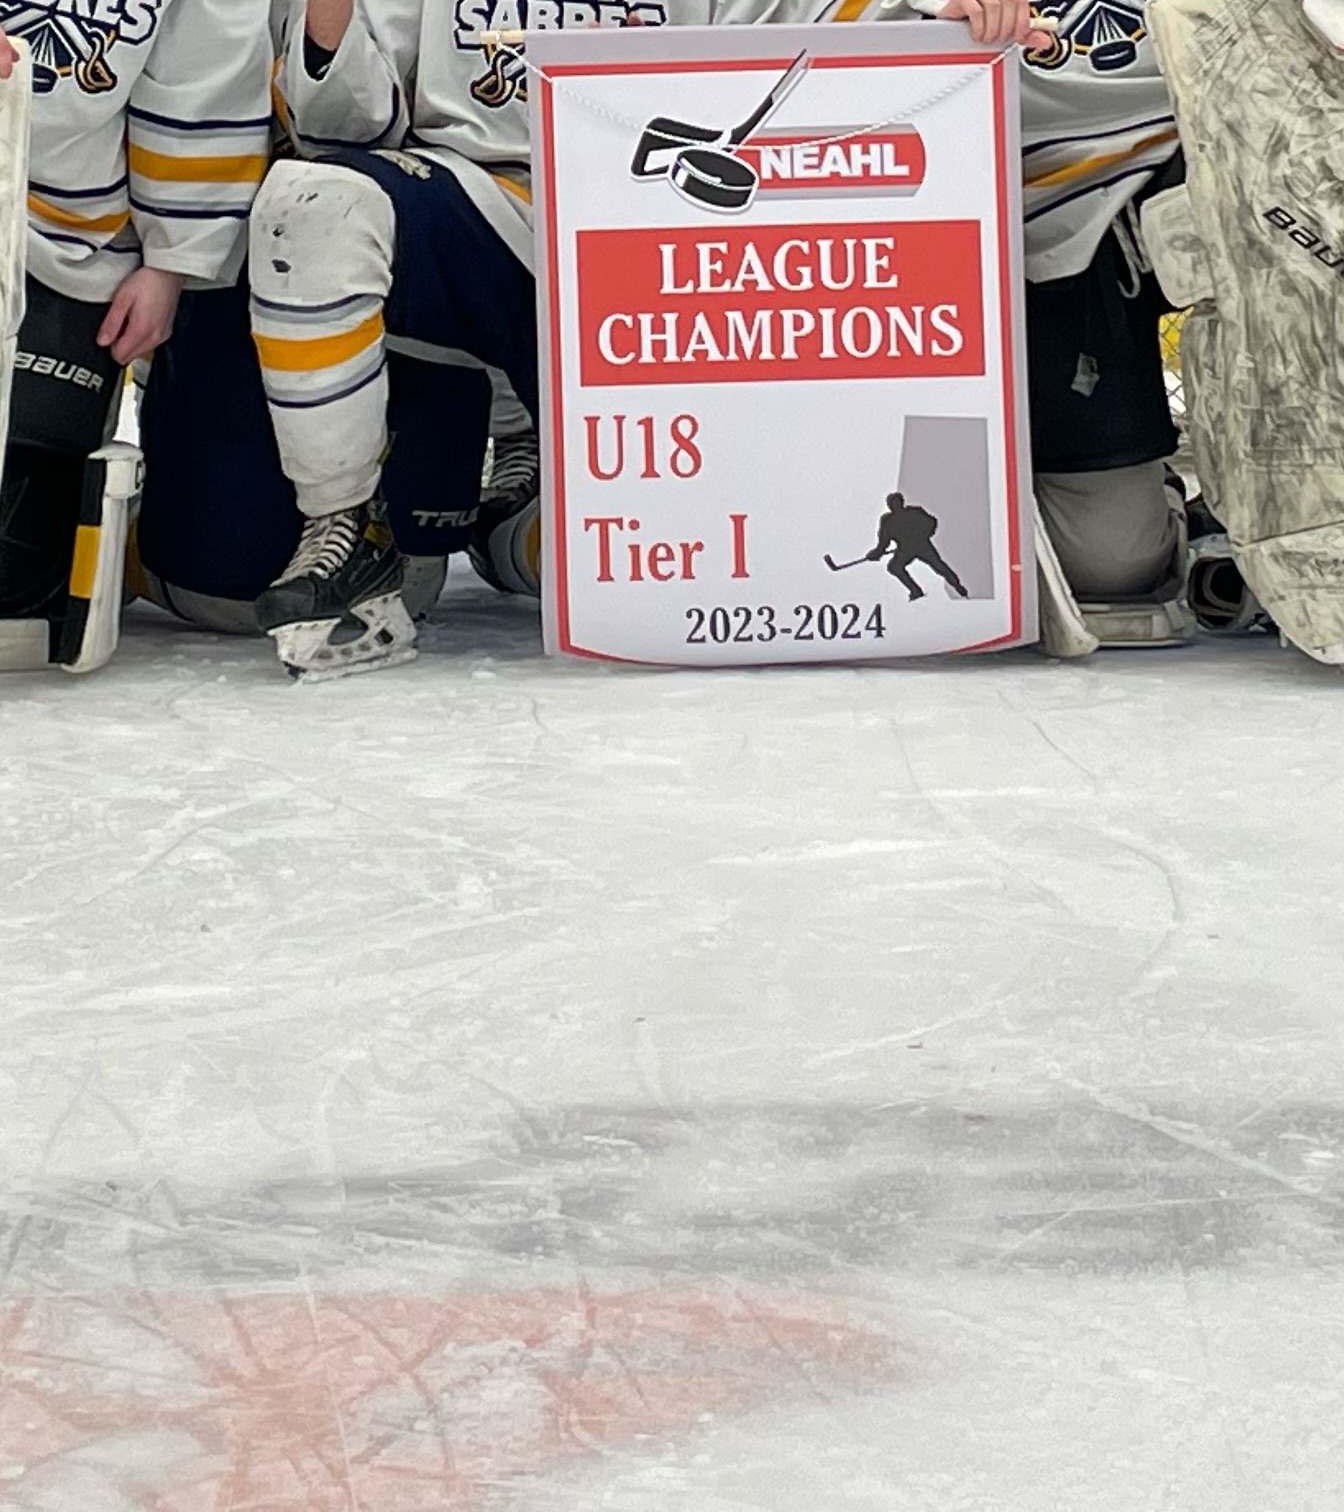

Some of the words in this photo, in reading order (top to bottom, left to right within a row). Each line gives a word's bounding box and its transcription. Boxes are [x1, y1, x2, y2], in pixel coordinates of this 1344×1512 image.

[759, 142, 911, 180] NEAHL
[657, 236, 898, 294] LEAGUE
[597, 304, 964, 366] CHAMPIONS
[14, 350, 104, 394] BAUER
[584, 413, 703, 481] U18
[412, 505, 481, 528] TRU
[584, 514, 705, 582] Tier
[728, 513, 749, 579] I
[685, 602, 887, 644] 2023-2024
